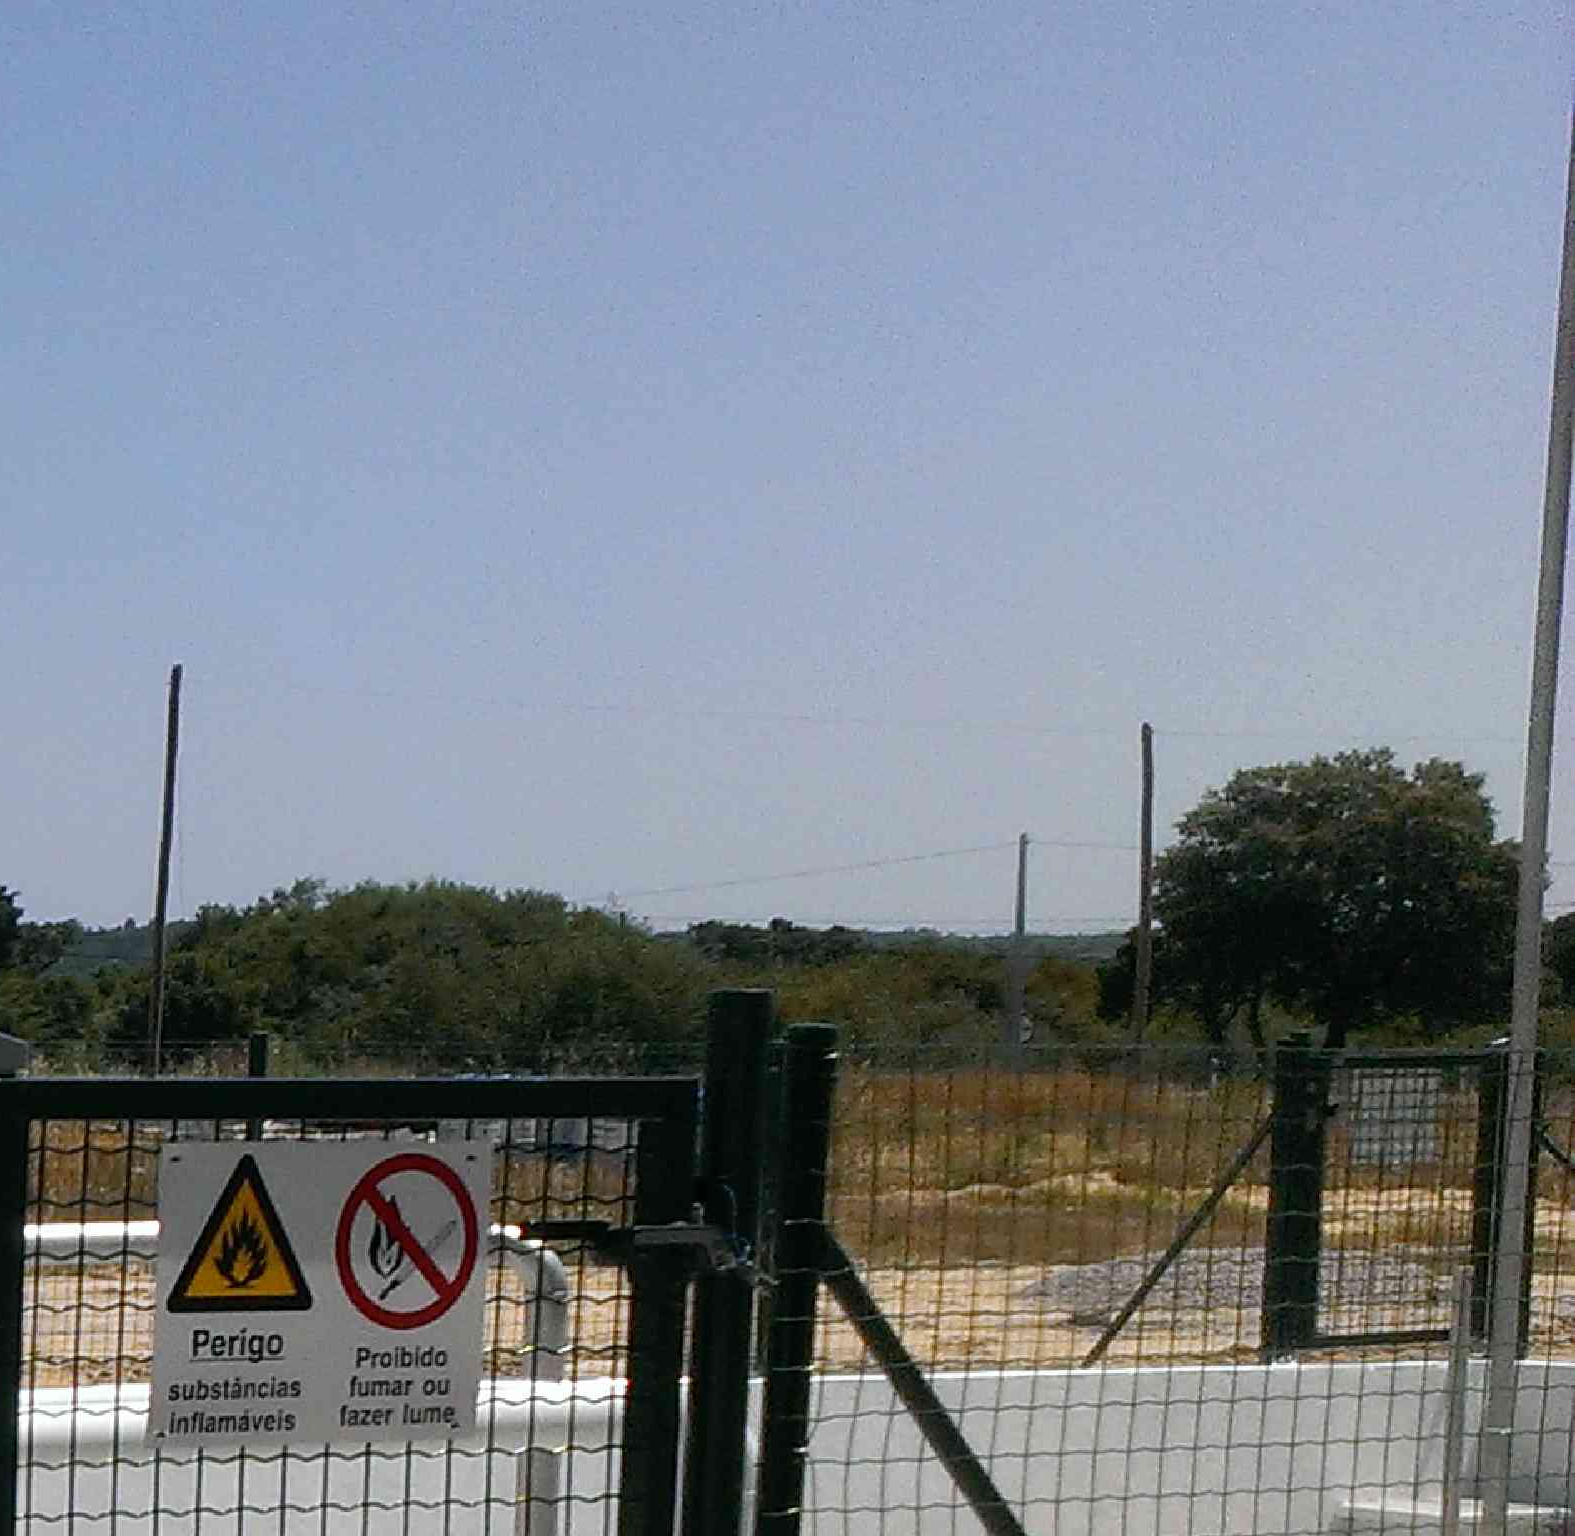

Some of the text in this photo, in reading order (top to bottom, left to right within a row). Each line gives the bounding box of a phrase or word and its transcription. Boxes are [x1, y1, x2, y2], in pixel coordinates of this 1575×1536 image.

[192, 1328, 284, 1362] Perigo
[355, 1345, 449, 1369] Proibido
[167, 1376, 302, 1402] substâncias
[349, 1376, 451, 1398] fumar ou
[168, 1409, 297, 1435] inflamáveis
[339, 1403, 456, 1428] fazer lume
